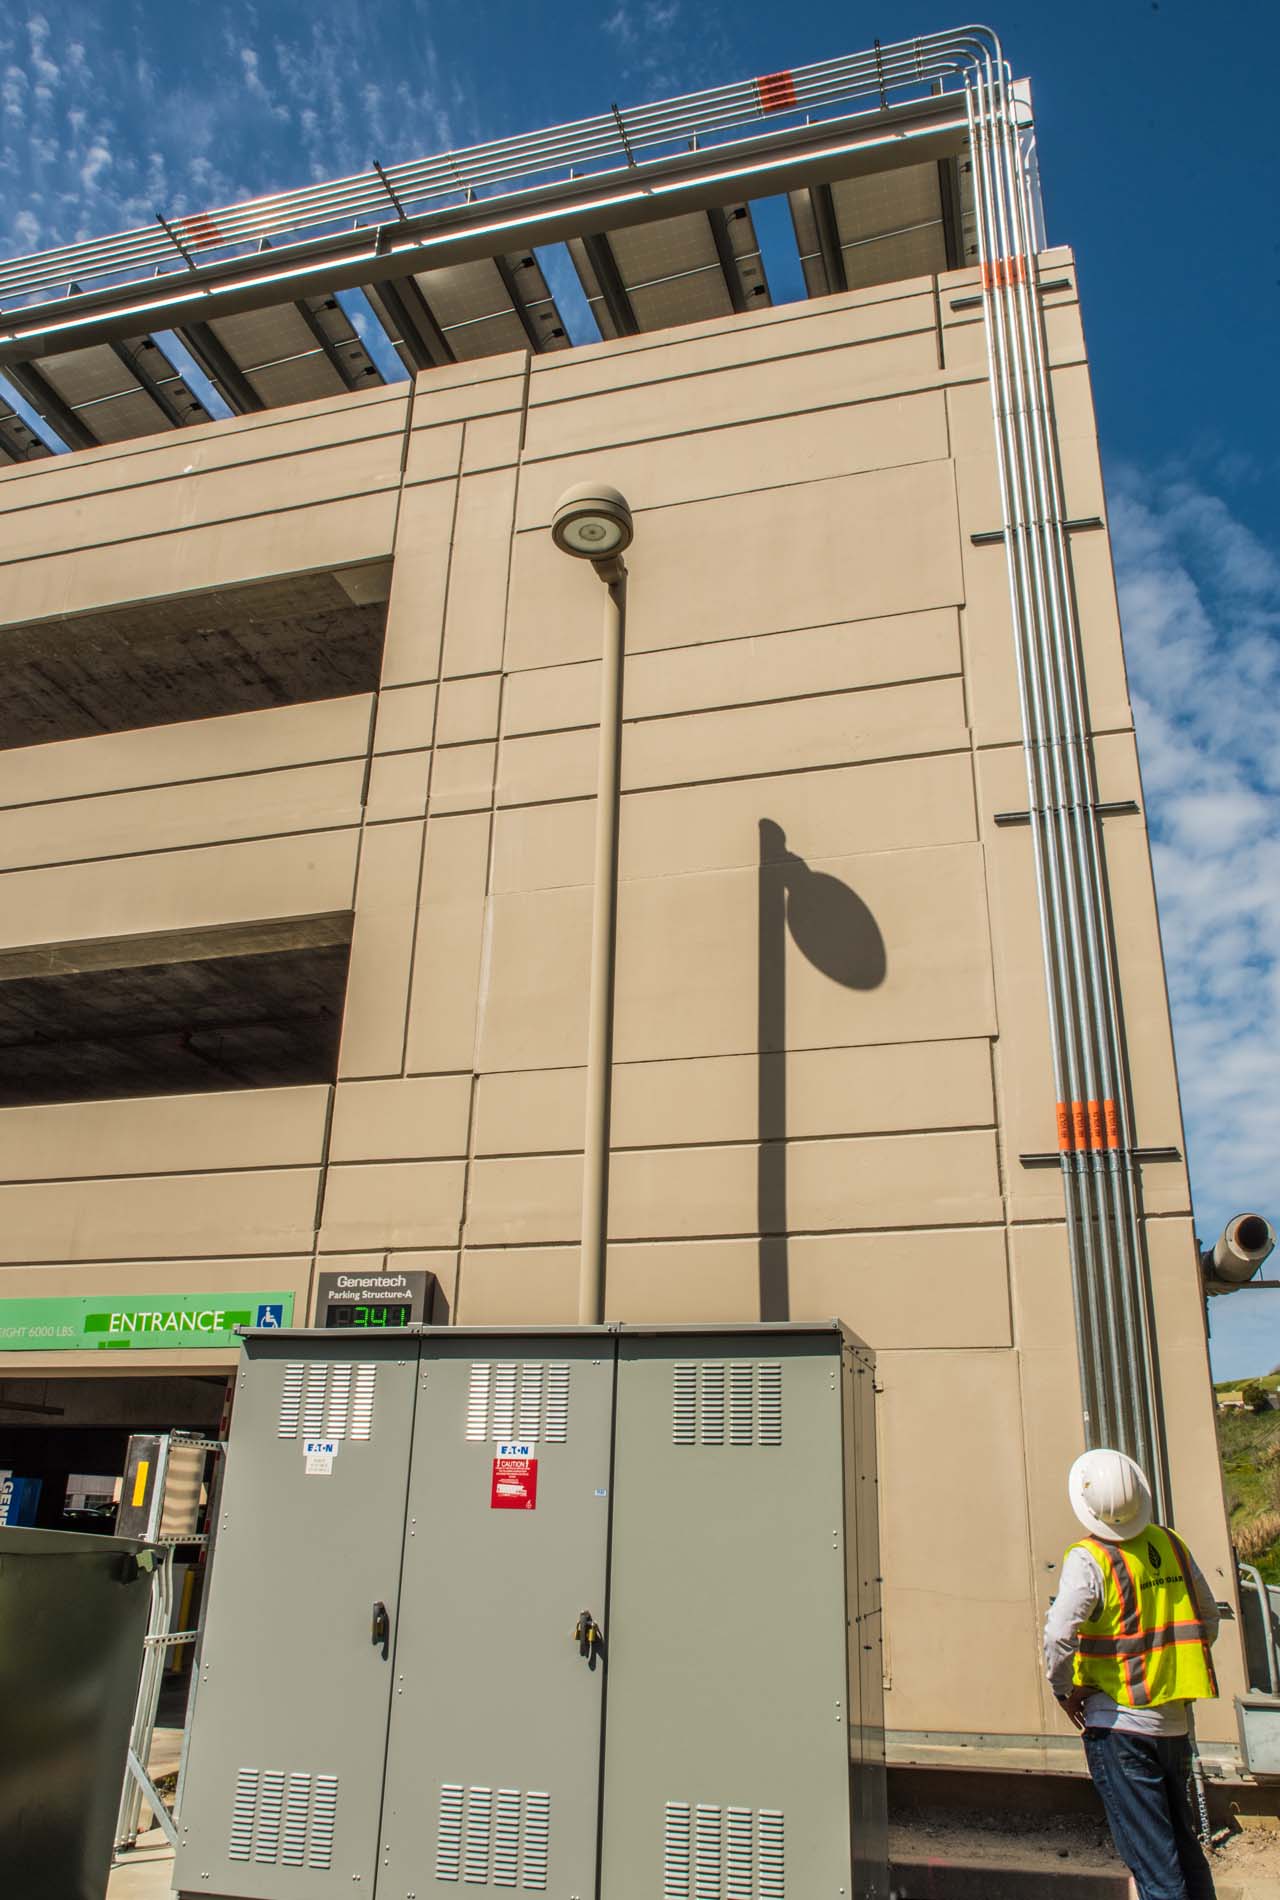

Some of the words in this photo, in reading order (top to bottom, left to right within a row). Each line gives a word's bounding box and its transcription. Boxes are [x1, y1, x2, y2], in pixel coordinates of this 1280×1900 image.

[337, 1275, 406, 1288] Genentech
[328, 1291, 360, 1300] Parking
[362, 1290, 412, 1299] Structure-A
[109, 1311, 224, 1332] ENTRANCE
[28, 1326, 54, 1337] 6000
